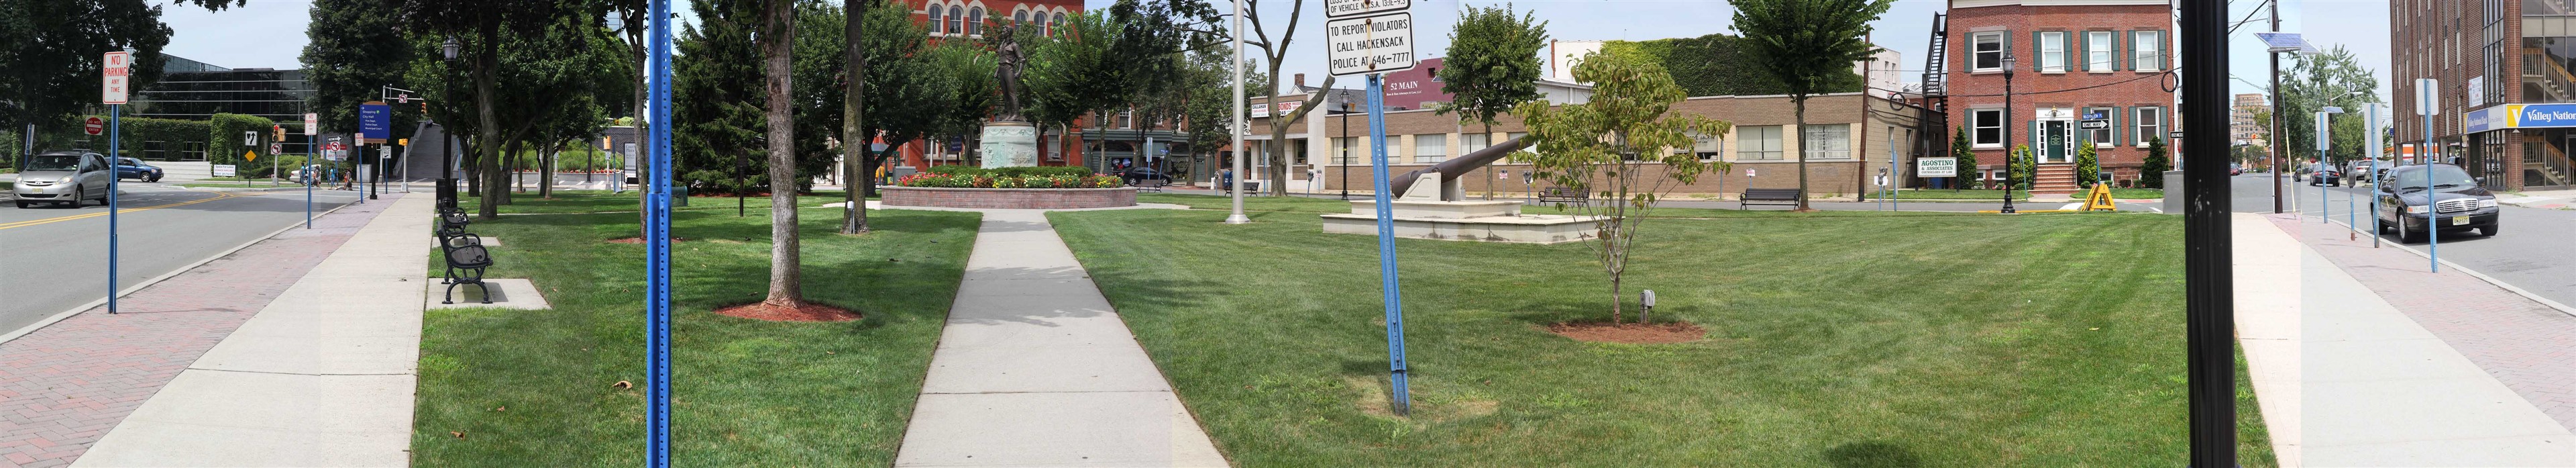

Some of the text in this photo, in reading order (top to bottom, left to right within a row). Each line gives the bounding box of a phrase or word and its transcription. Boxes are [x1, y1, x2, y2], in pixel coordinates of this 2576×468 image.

[1339, 3, 1359, 12] VEHICLE
[1330, 19, 1407, 36] TO REPORT VIOLATORS
[1336, 36, 1403, 52] CALL HACKENSACK
[111, 55, 120, 65] NO
[1333, 52, 1409, 68] POLICE AT 646-7777
[105, 67, 127, 77] PARKING
[1399, 81, 1418, 89] MAIN
[2527, 109, 2552, 122] Valley
